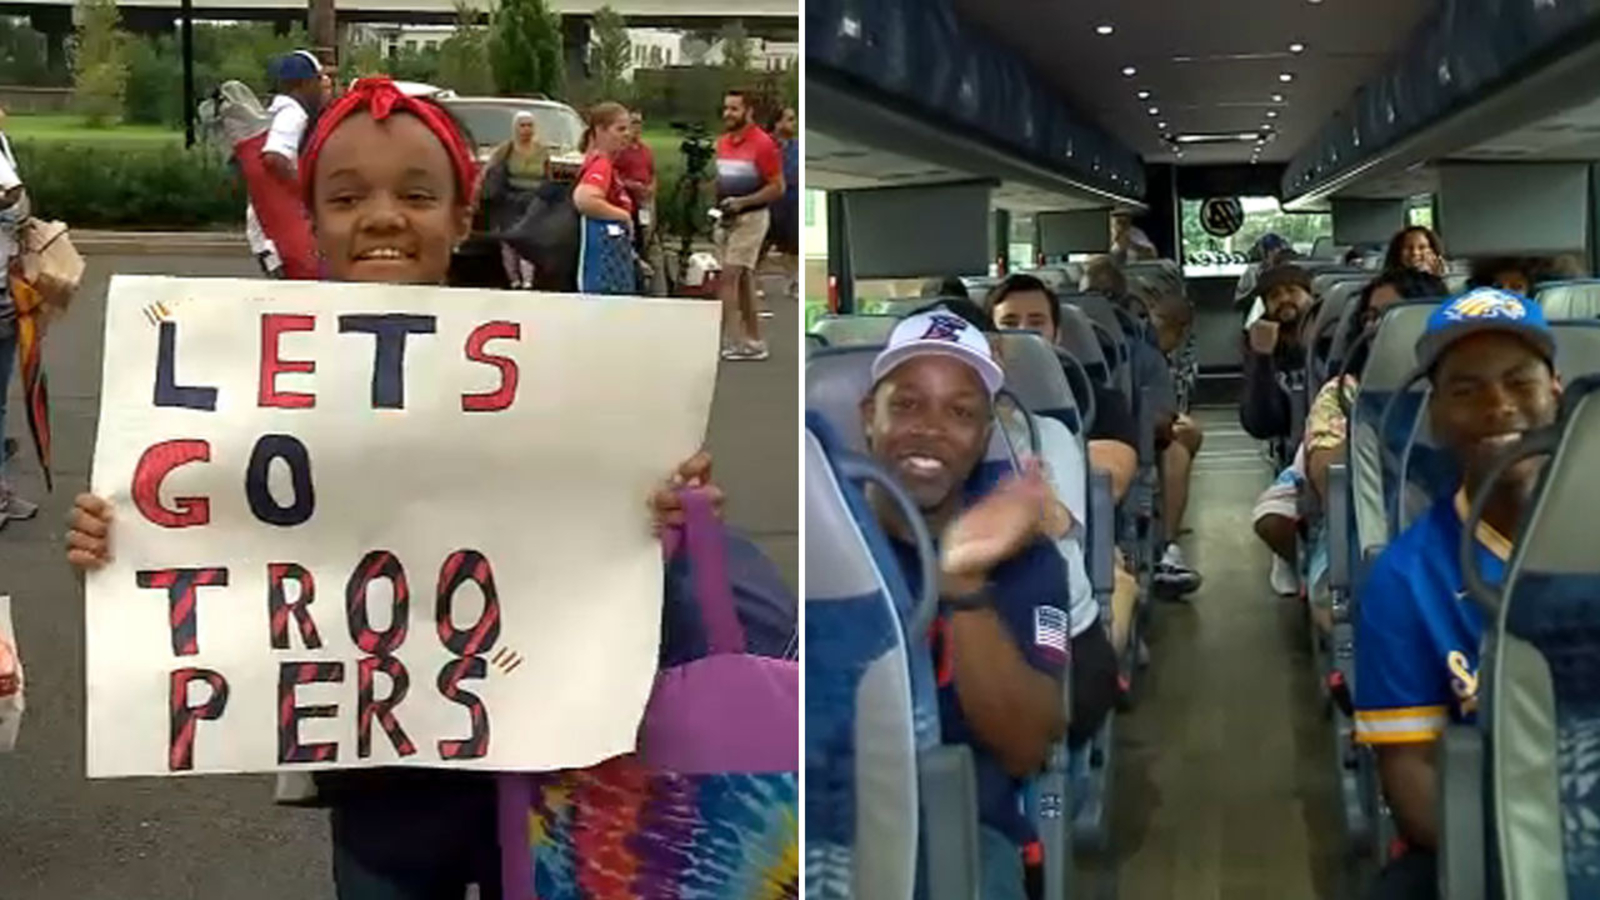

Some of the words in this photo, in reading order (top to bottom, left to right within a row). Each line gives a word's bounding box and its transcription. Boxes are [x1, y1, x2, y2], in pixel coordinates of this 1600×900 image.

[153, 313, 521, 412] LETS
[131, 433, 316, 528] GO
[136, 549, 502, 657] TROO
[168, 655, 492, 771] PERS
